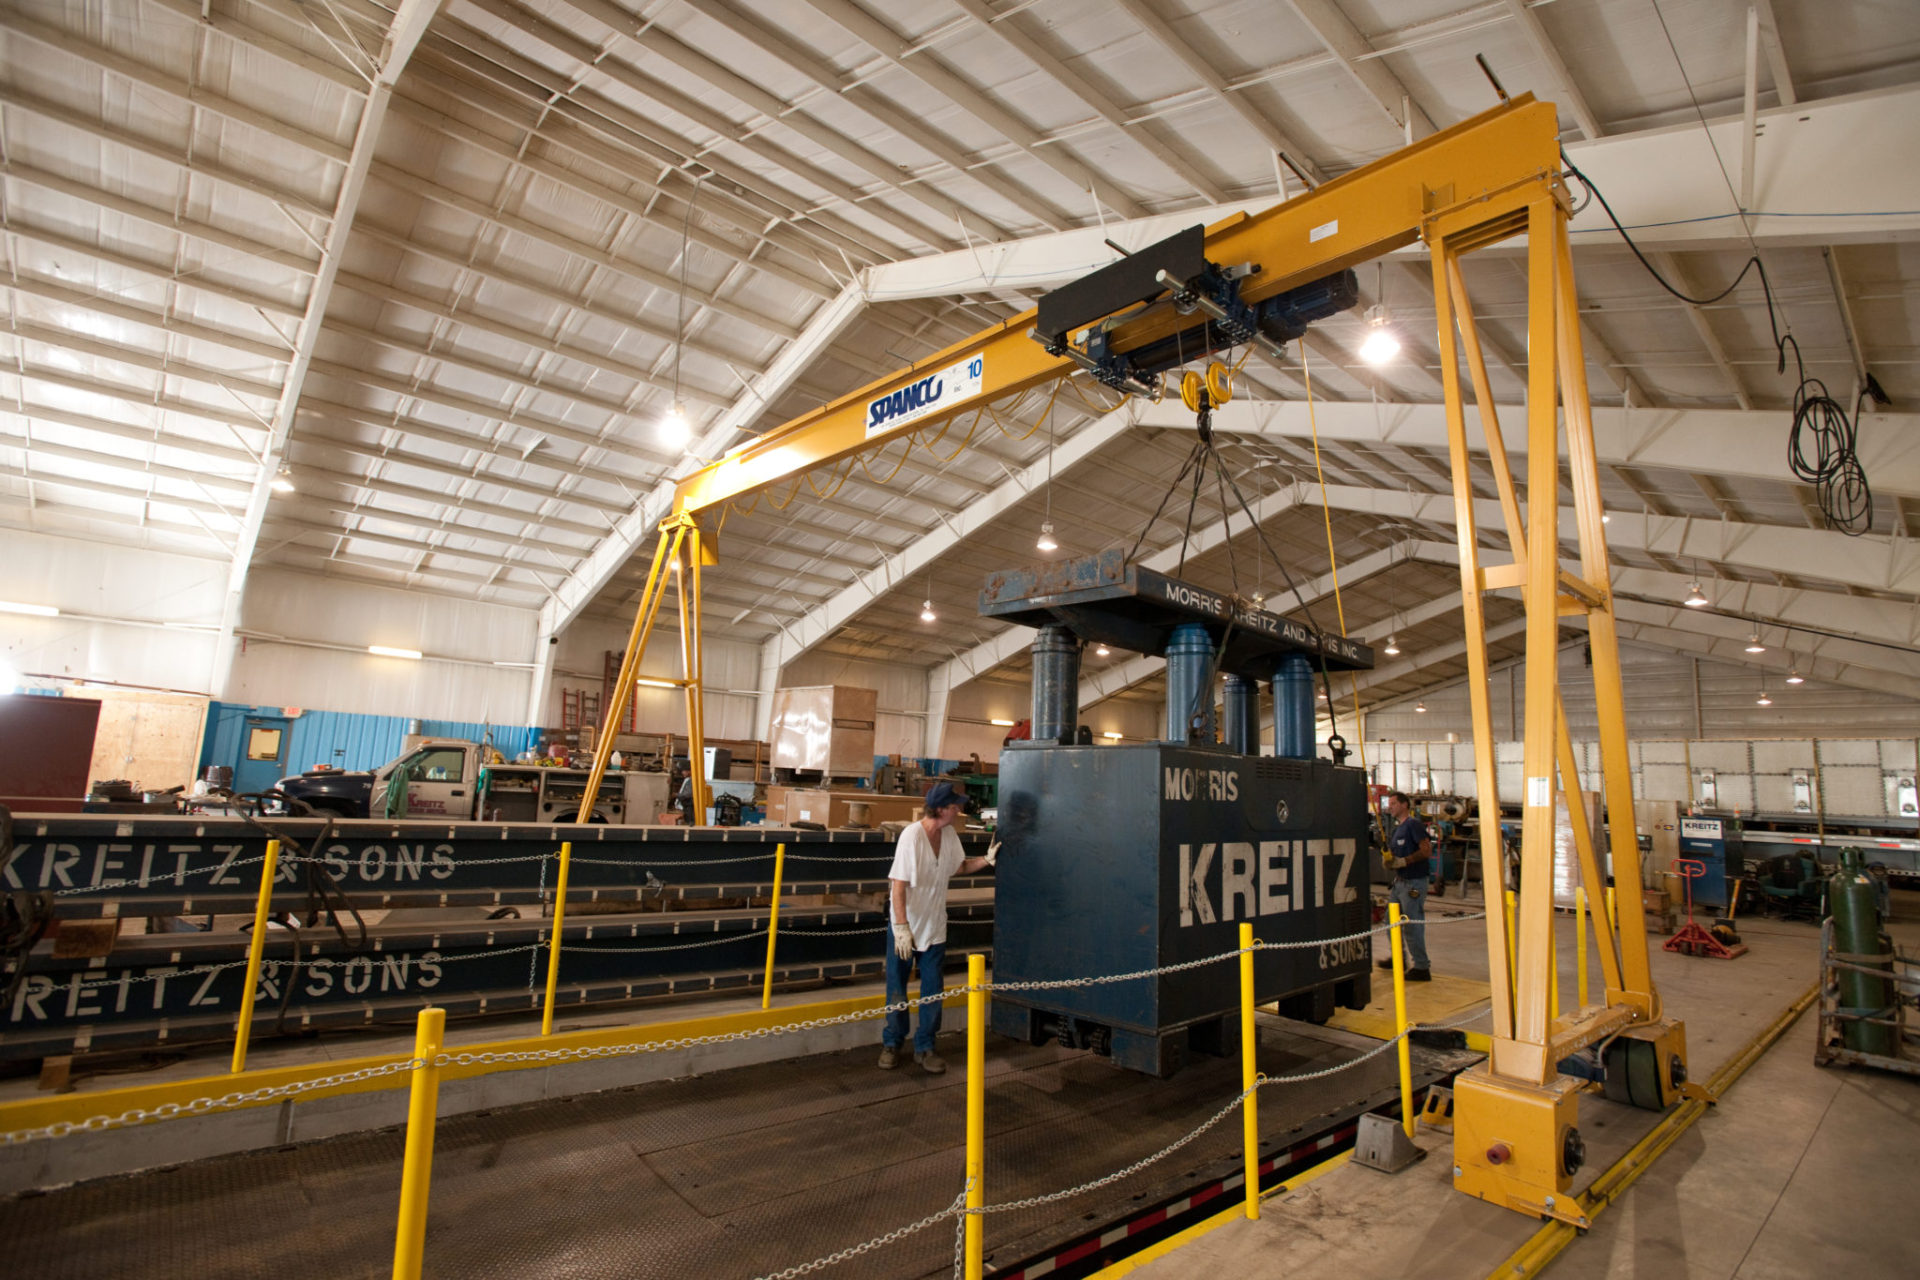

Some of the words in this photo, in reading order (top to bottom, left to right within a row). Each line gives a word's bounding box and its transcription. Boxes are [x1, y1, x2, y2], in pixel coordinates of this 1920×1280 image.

[967, 358, 982, 379] 10
[868, 374, 943, 428] SPANCO
[1166, 582, 1223, 615] MORRIS
[1283, 626, 1306, 644] AND
[1684, 822, 1719, 831] KREITZ
[324, 844, 456, 882] SONS
[1178, 838, 1358, 928] KREITZ
[1330, 934, 1365, 967] SONS
[10, 965, 224, 1022] REITZ
[305, 951, 443, 997] SONS
